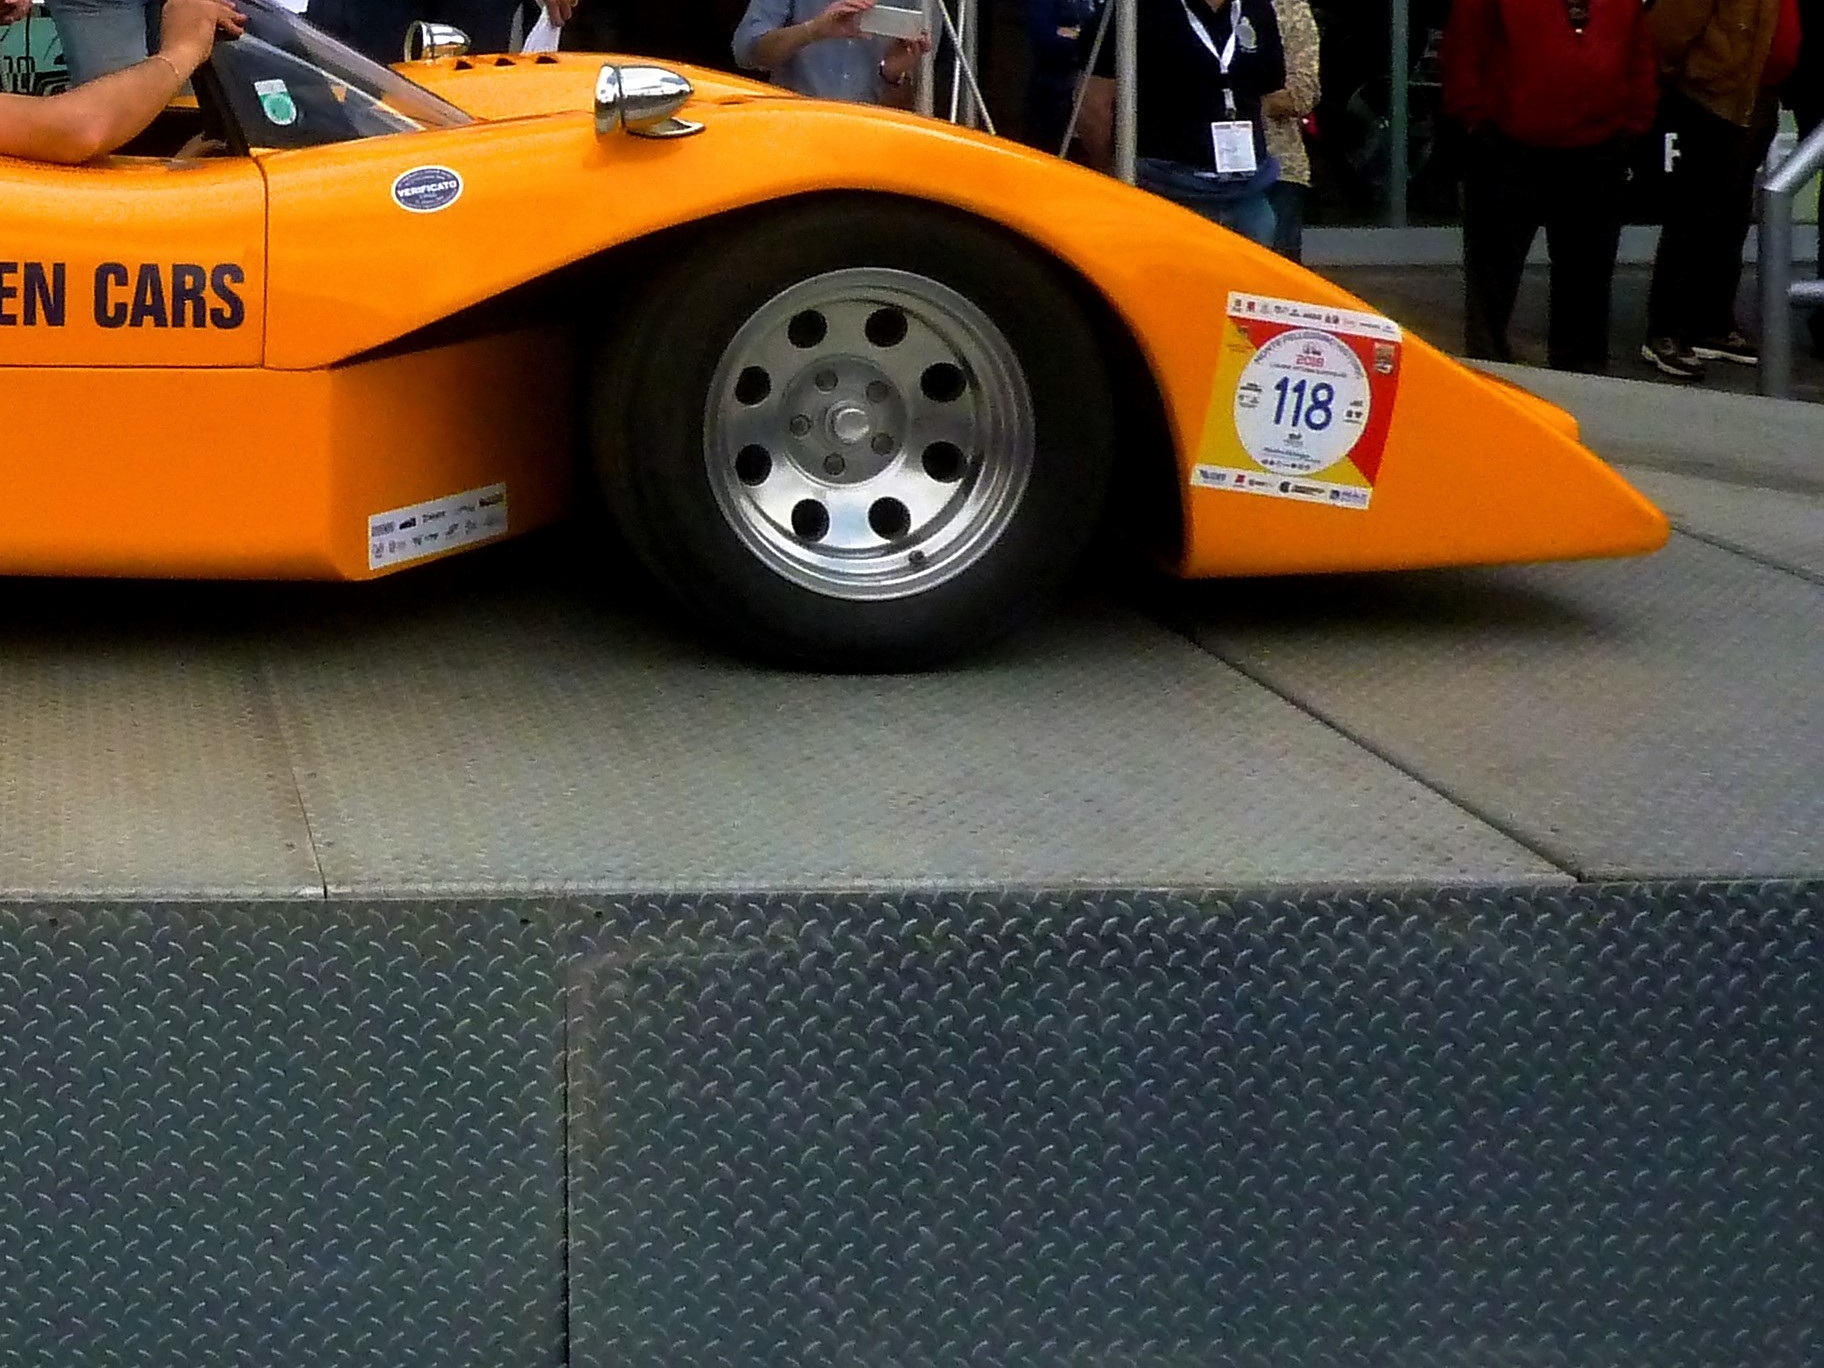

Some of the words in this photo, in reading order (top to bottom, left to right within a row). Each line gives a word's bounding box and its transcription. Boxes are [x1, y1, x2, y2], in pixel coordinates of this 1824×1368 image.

[396, 179, 457, 198] VERIFICATO
[93, 261, 246, 331] CARS
[1273, 375, 1335, 431] 118
